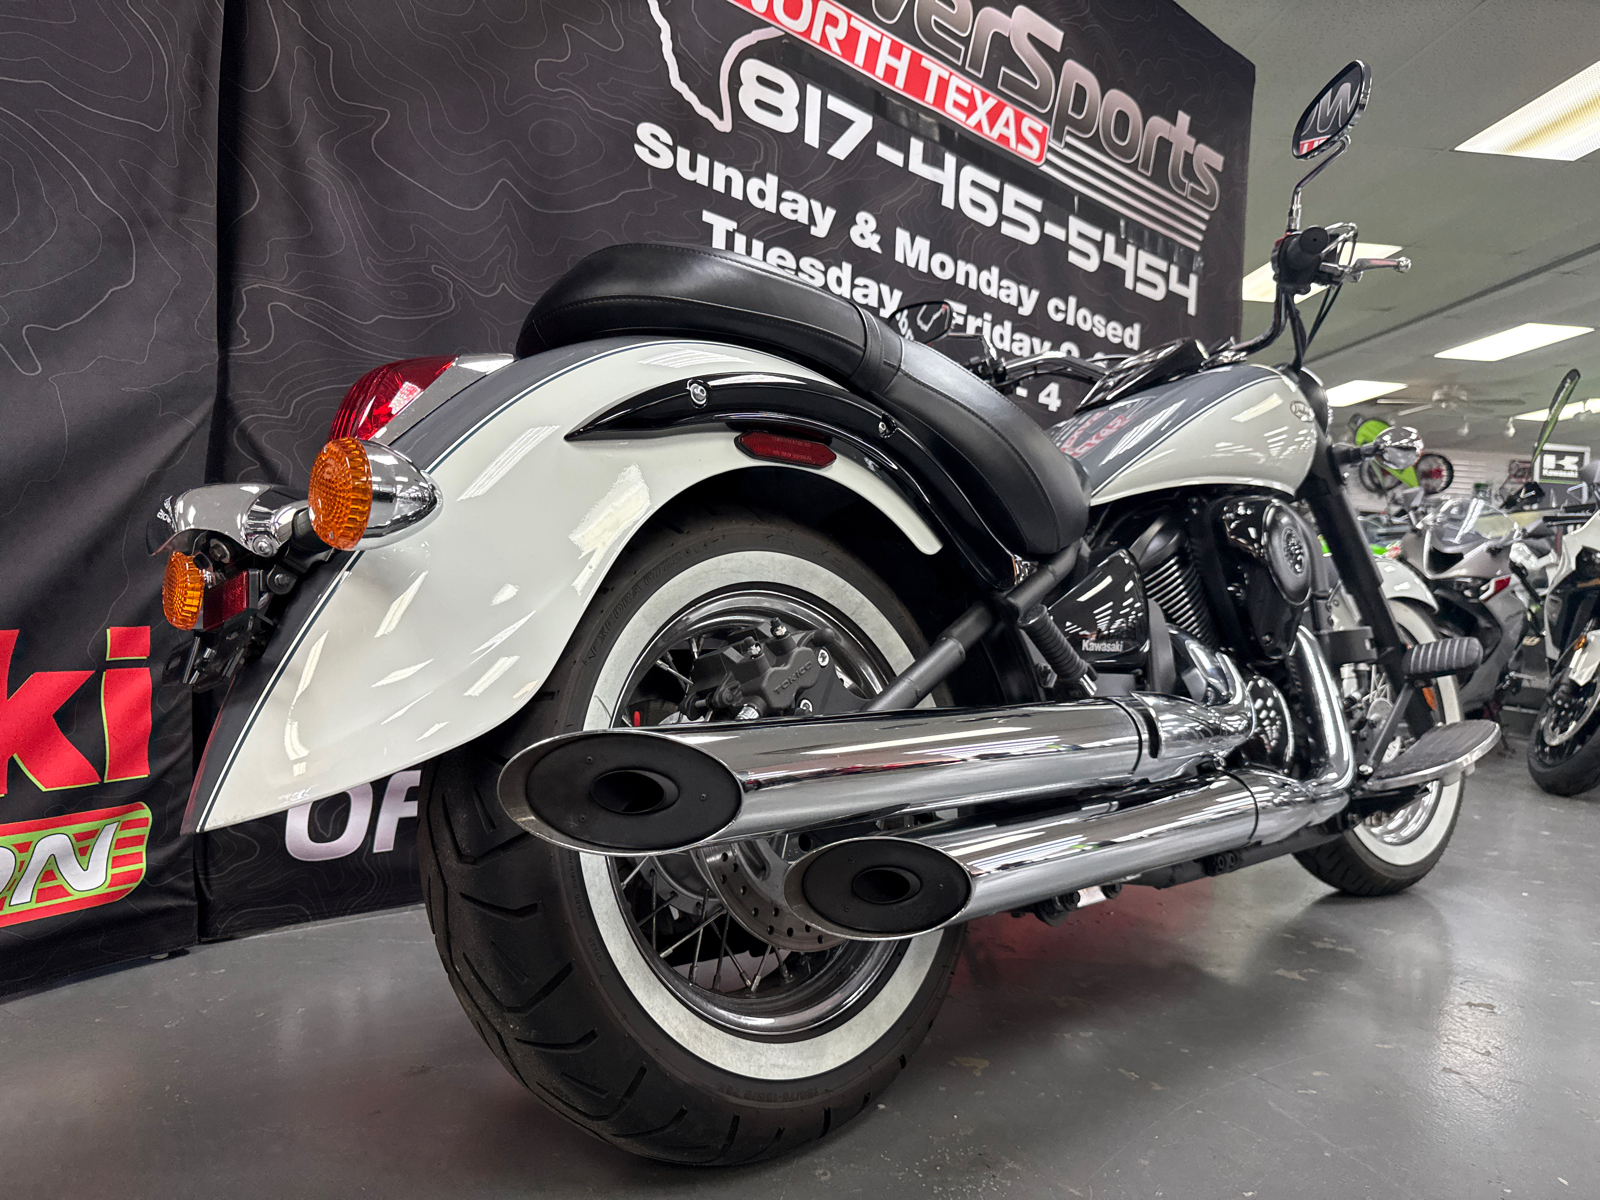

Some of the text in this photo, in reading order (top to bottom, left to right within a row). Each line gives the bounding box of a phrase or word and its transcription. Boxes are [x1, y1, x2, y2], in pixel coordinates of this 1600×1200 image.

[751, 0, 1043, 161] ORTH TEXAS
[634, 122, 1141, 350] Sunday & Monday closed
[738, 58, 1198, 316] 817-465-5454
[702, 209, 903, 319] Tuesday
[1038, 382, 1062, 412] 4
[773, 660, 812, 695] TOKICO
[1081, 639, 1124, 652] Kawasaki
[0, 821, 120, 907] N
